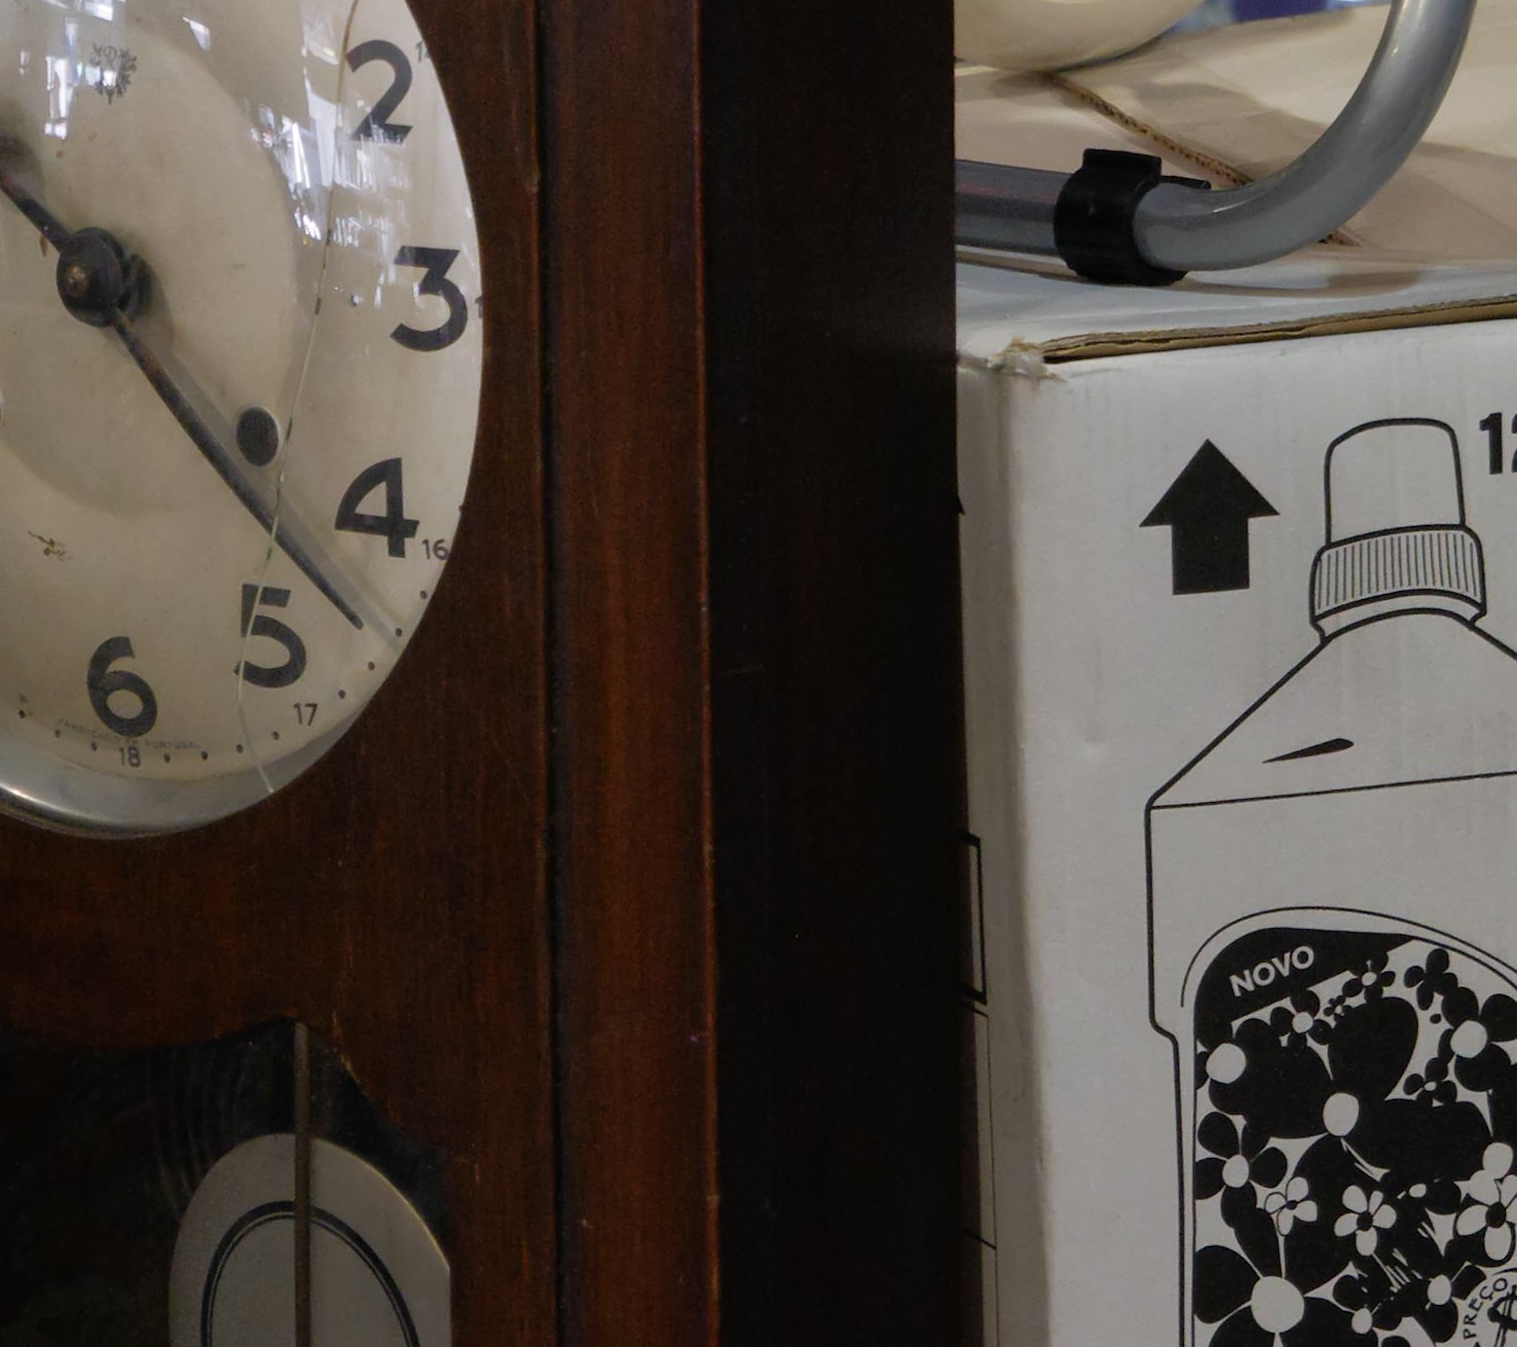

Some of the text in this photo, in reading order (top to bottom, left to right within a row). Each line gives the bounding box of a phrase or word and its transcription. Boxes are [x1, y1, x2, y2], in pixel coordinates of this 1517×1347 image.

[345, 39, 413, 144] 2
[390, 245, 468, 352] 3
[334, 457, 420, 559] 4
[421, 538, 450, 561] 16
[233, 583, 307, 689] 5
[86, 636, 158, 738] 6
[293, 701, 319, 727] 17
[118, 746, 142, 768] 18
[1229, 945, 1315, 997] NOVO
[1462, 1277, 1508, 1341] PREÇO
